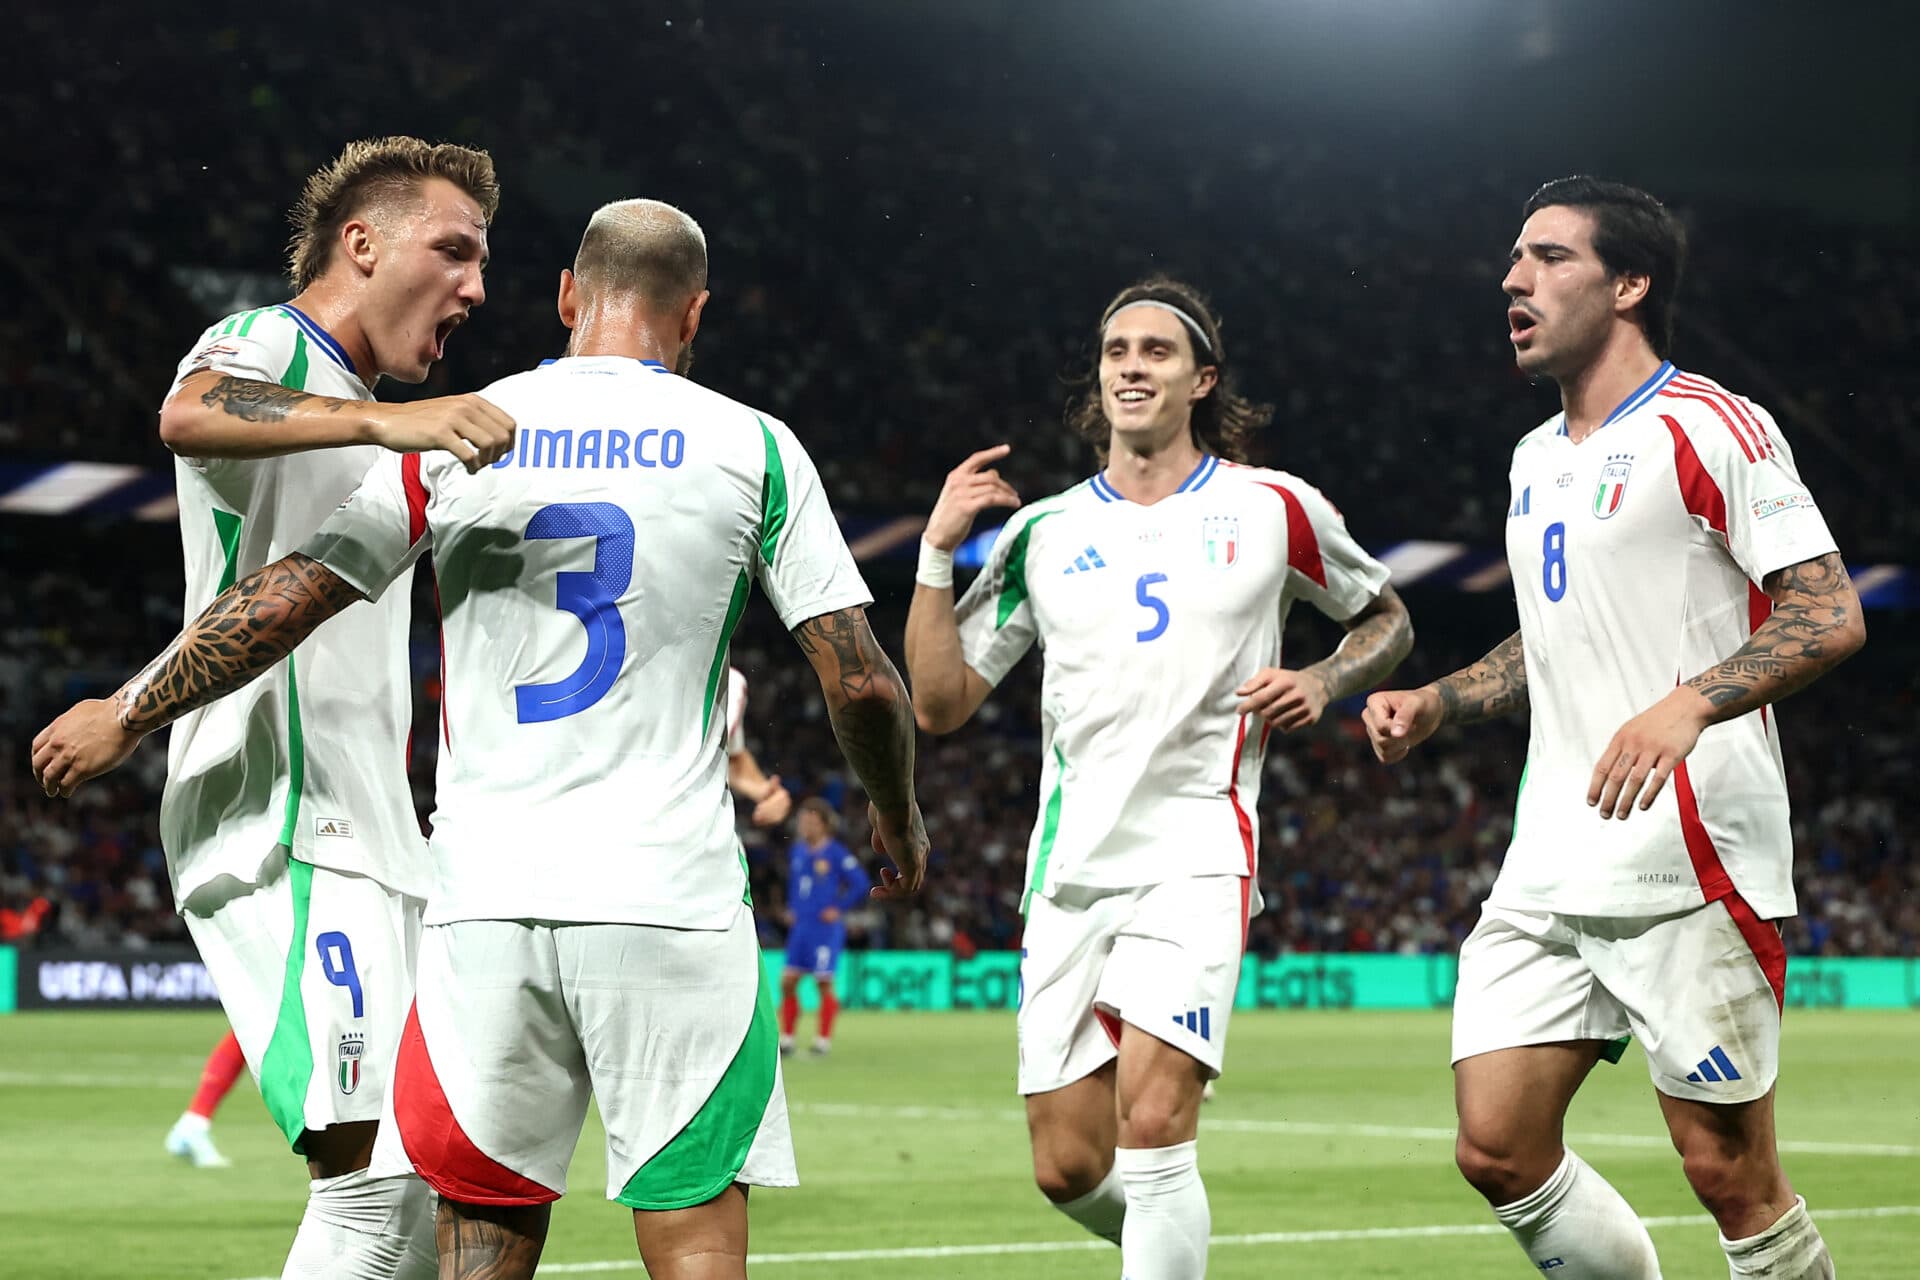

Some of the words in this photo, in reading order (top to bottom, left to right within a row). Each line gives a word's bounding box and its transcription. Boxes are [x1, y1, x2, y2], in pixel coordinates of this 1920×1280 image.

[492, 428, 685, 469] IMARCO
[1543, 521, 1567, 603] 8
[514, 502, 635, 724] 3
[1136, 572, 1170, 643] 5
[1637, 873, 1680, 884] HEAT.RDY
[38, 961, 129, 1001] UEFA
[316, 931, 364, 1018] 9
[340, 1045, 361, 1056] ITALIA
